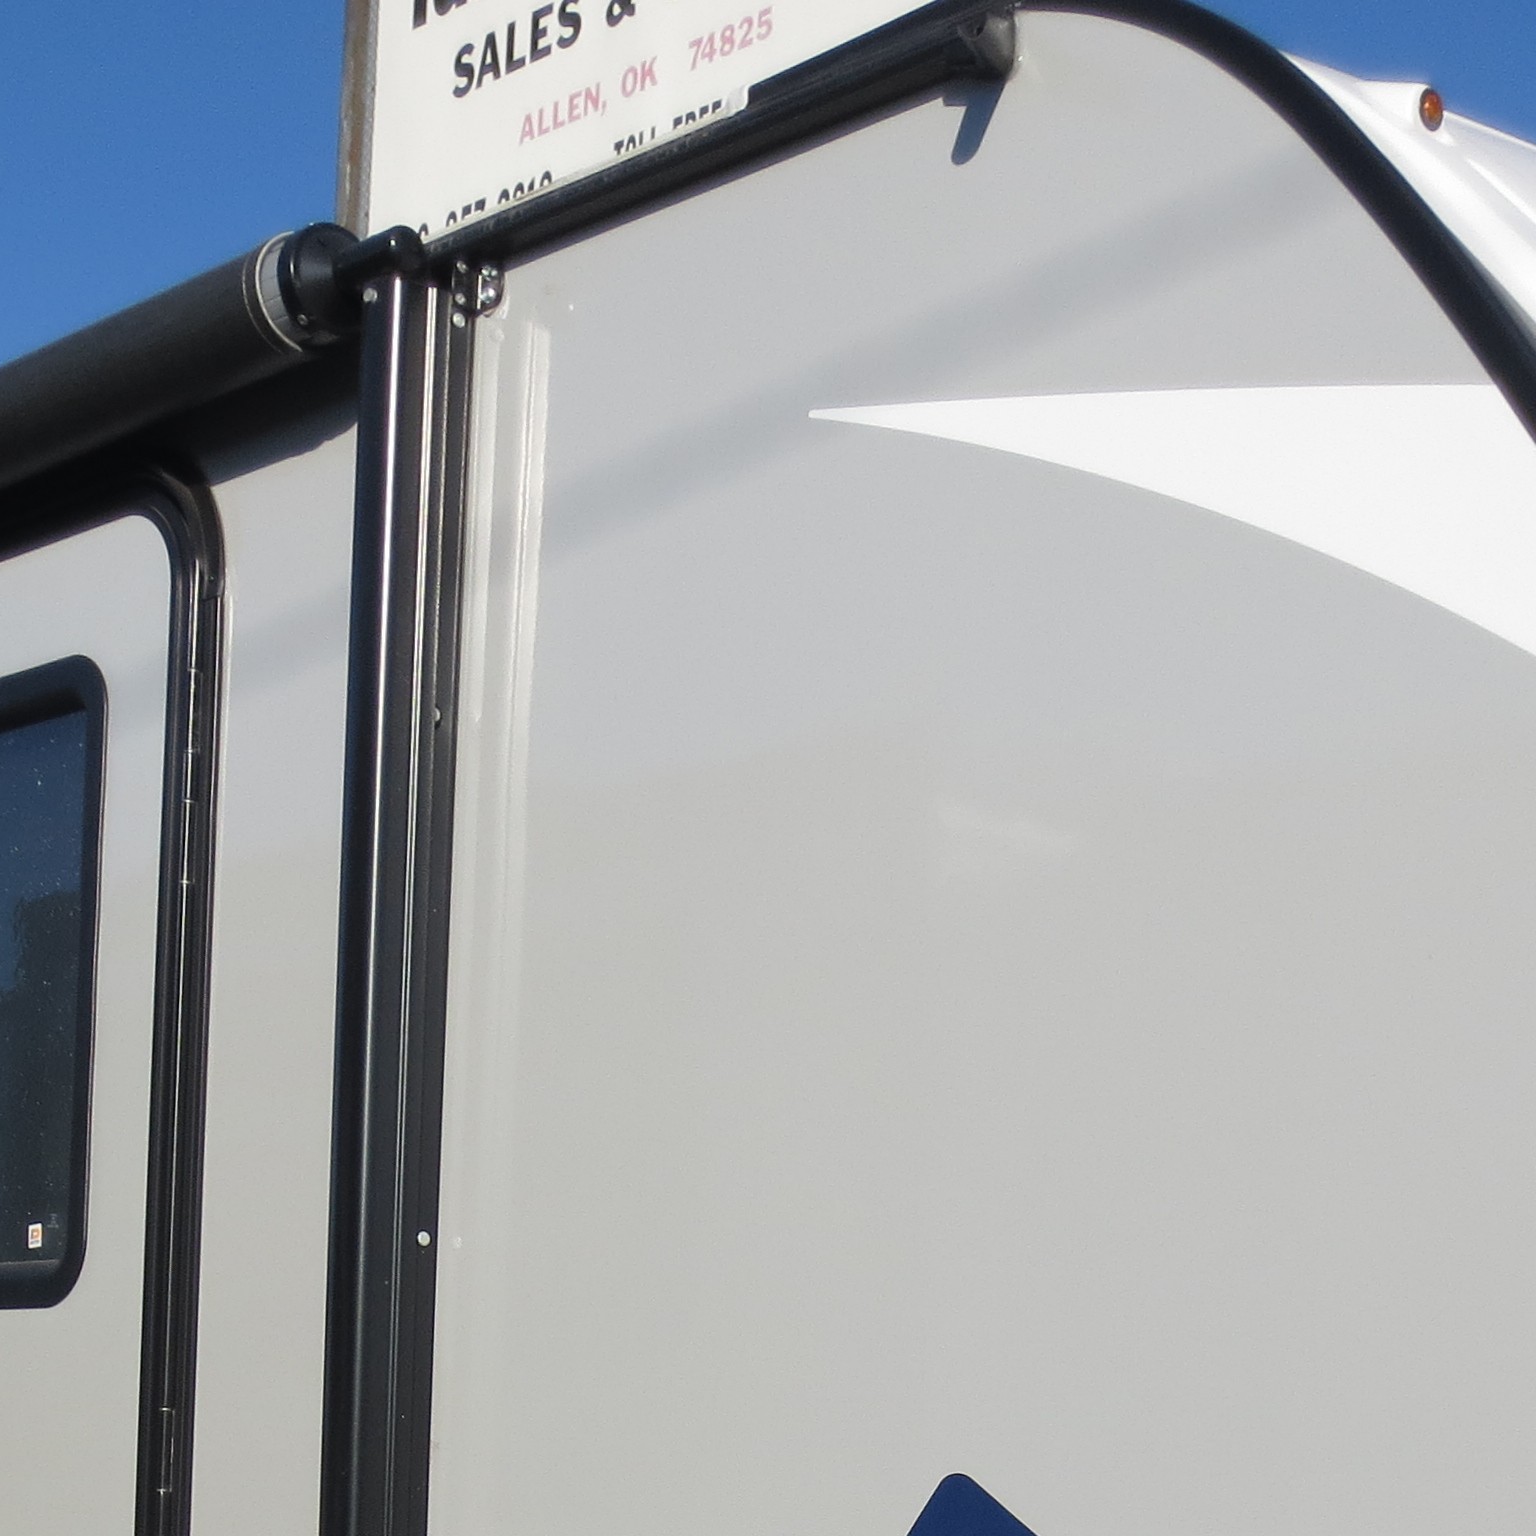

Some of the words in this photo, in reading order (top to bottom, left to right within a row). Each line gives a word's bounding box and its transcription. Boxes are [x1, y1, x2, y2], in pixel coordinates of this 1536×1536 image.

[452, 0, 582, 98] SALES
[519, 82, 607, 146] ALLEN,
[620, 55, 658, 98] OK
[688, 6, 773, 71] 74825
